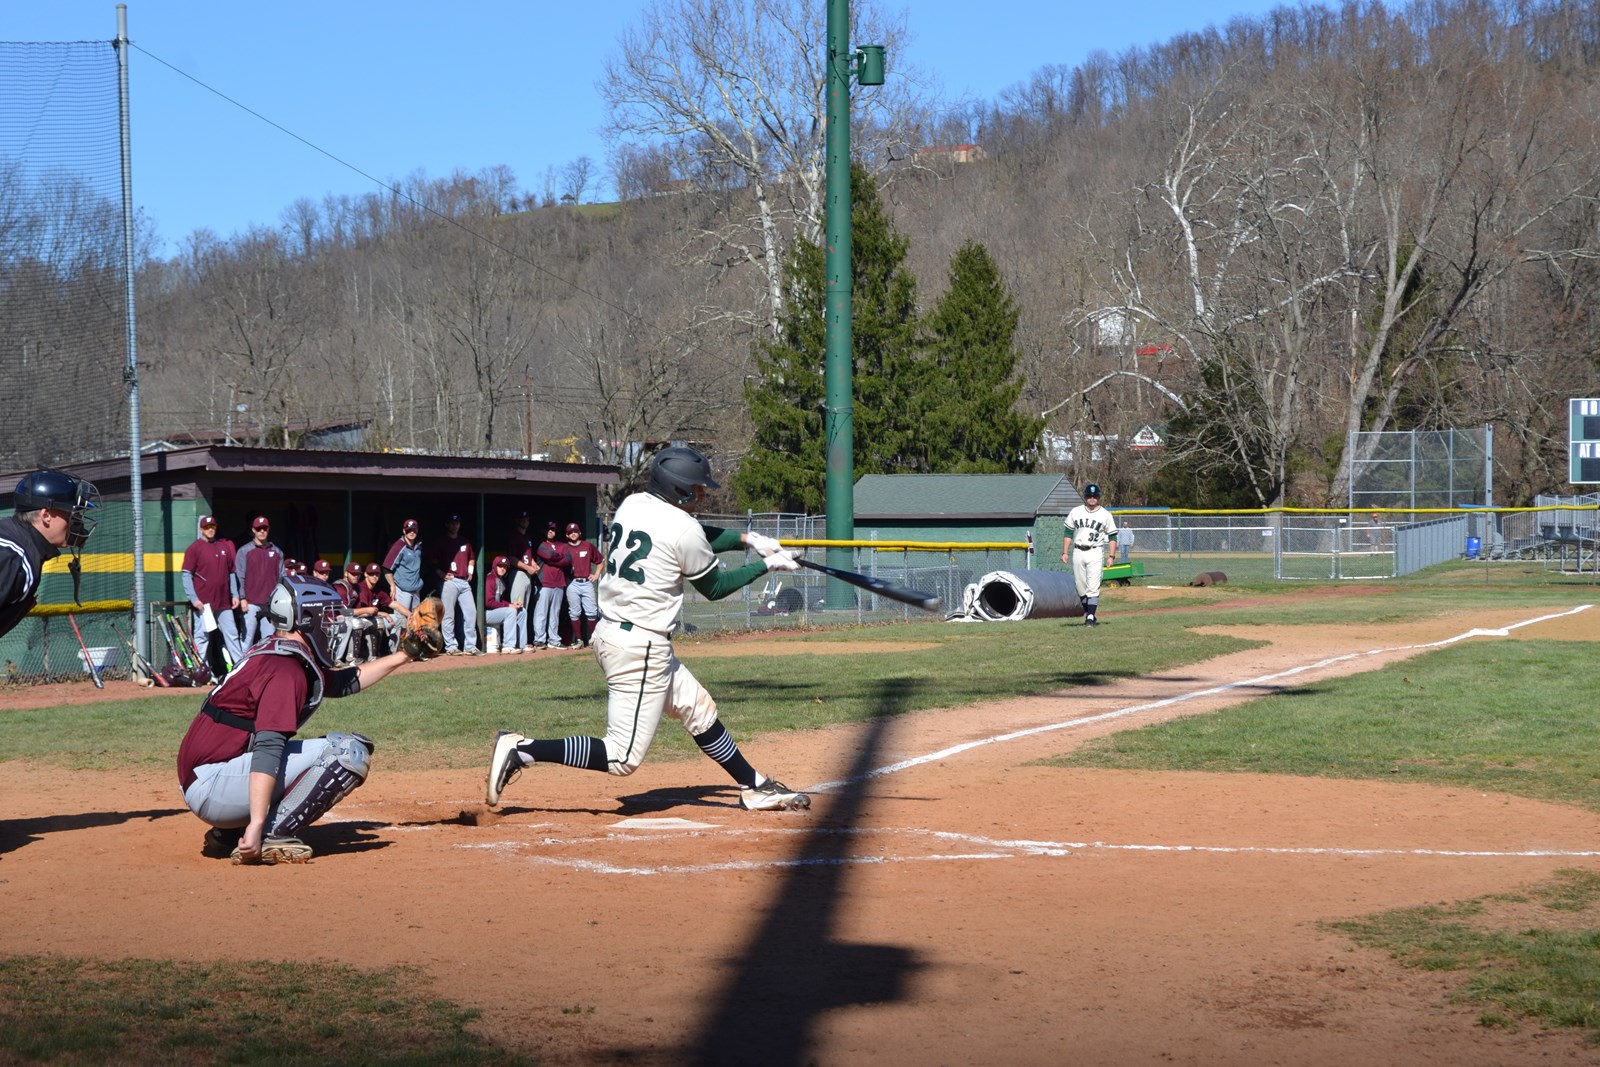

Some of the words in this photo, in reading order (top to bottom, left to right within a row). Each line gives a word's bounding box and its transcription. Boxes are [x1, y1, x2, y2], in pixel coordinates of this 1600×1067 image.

[1580, 443, 1591, 458] AT
[1074, 518, 1102, 532] SALEM
[1088, 532, 1100, 542] 32
[523, 555, 529, 564] 5
[607, 522, 652, 585] 22
